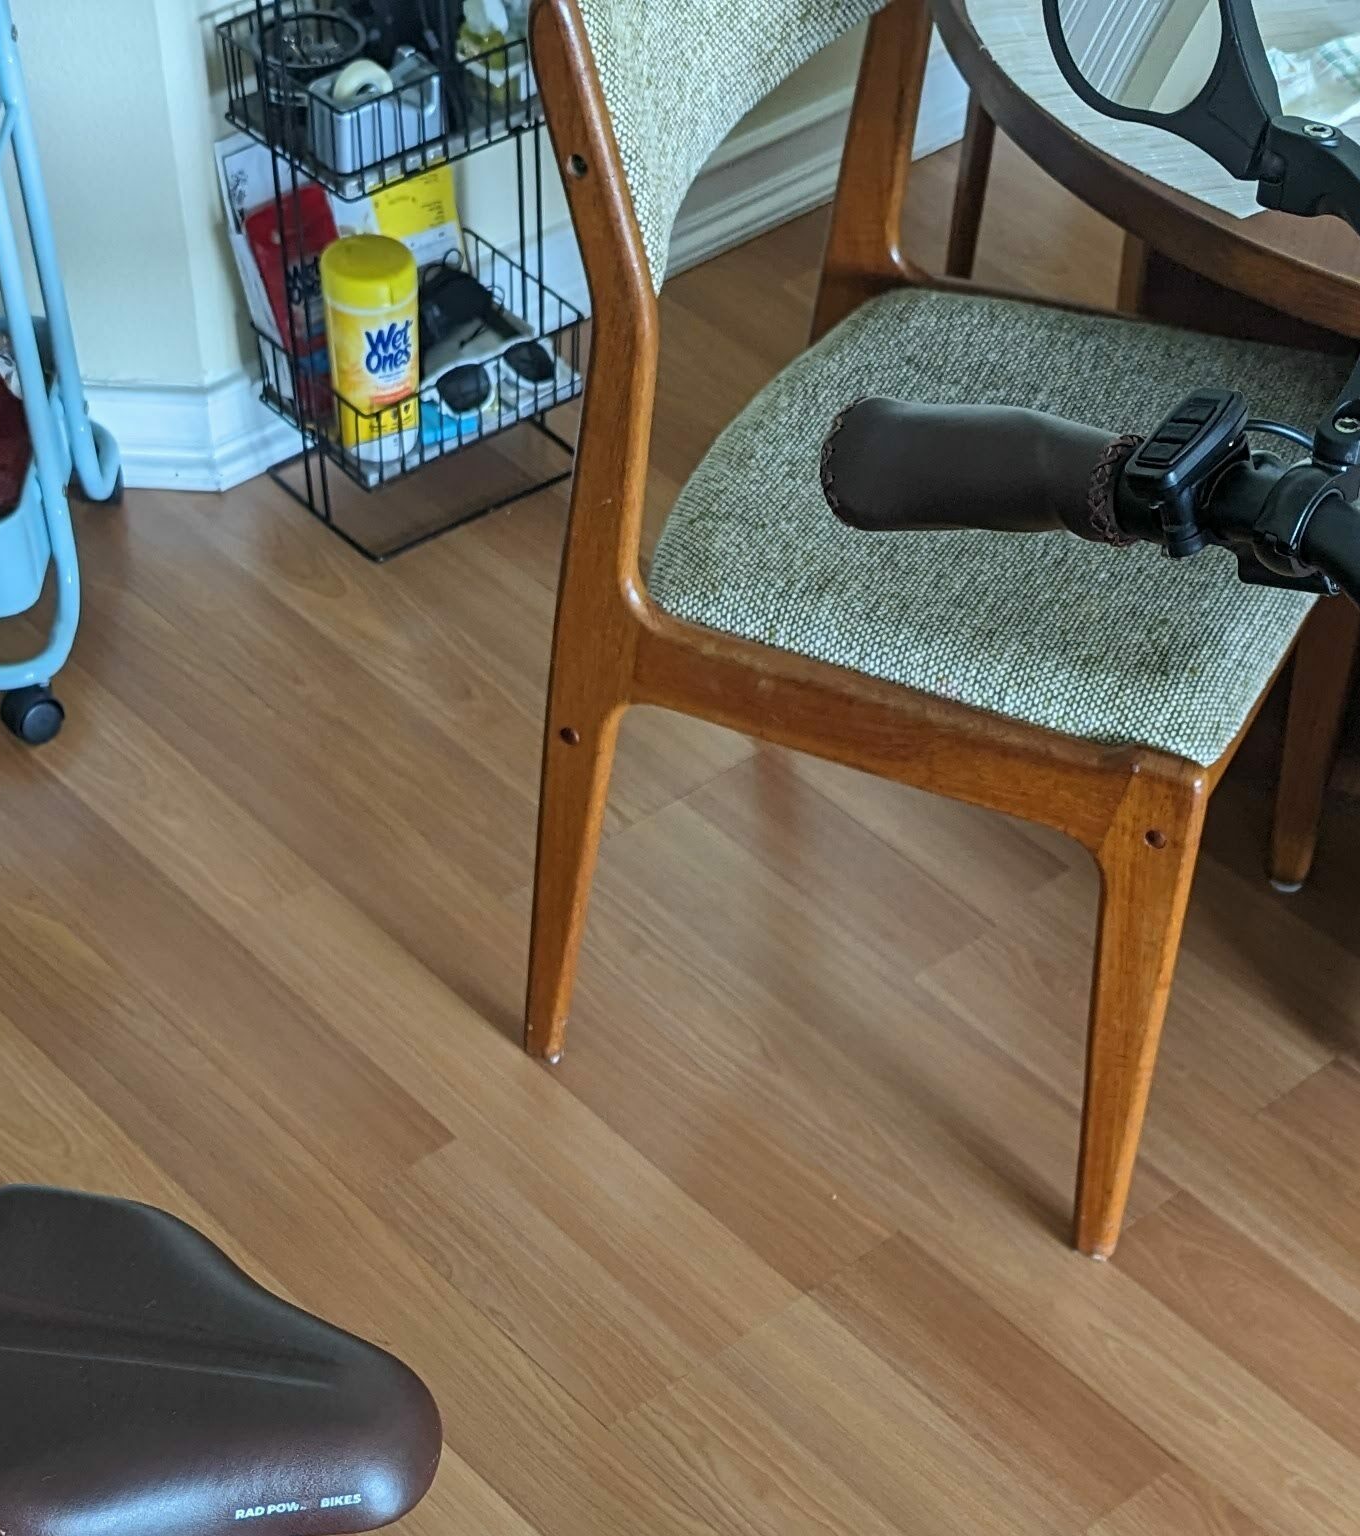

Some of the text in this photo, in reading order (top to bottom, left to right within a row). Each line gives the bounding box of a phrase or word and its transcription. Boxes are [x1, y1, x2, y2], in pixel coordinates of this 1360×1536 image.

[365, 319, 414, 353] Wet
[365, 344, 412, 374] Ones
[234, 1493, 362, 1520] RAD POW BIKES
